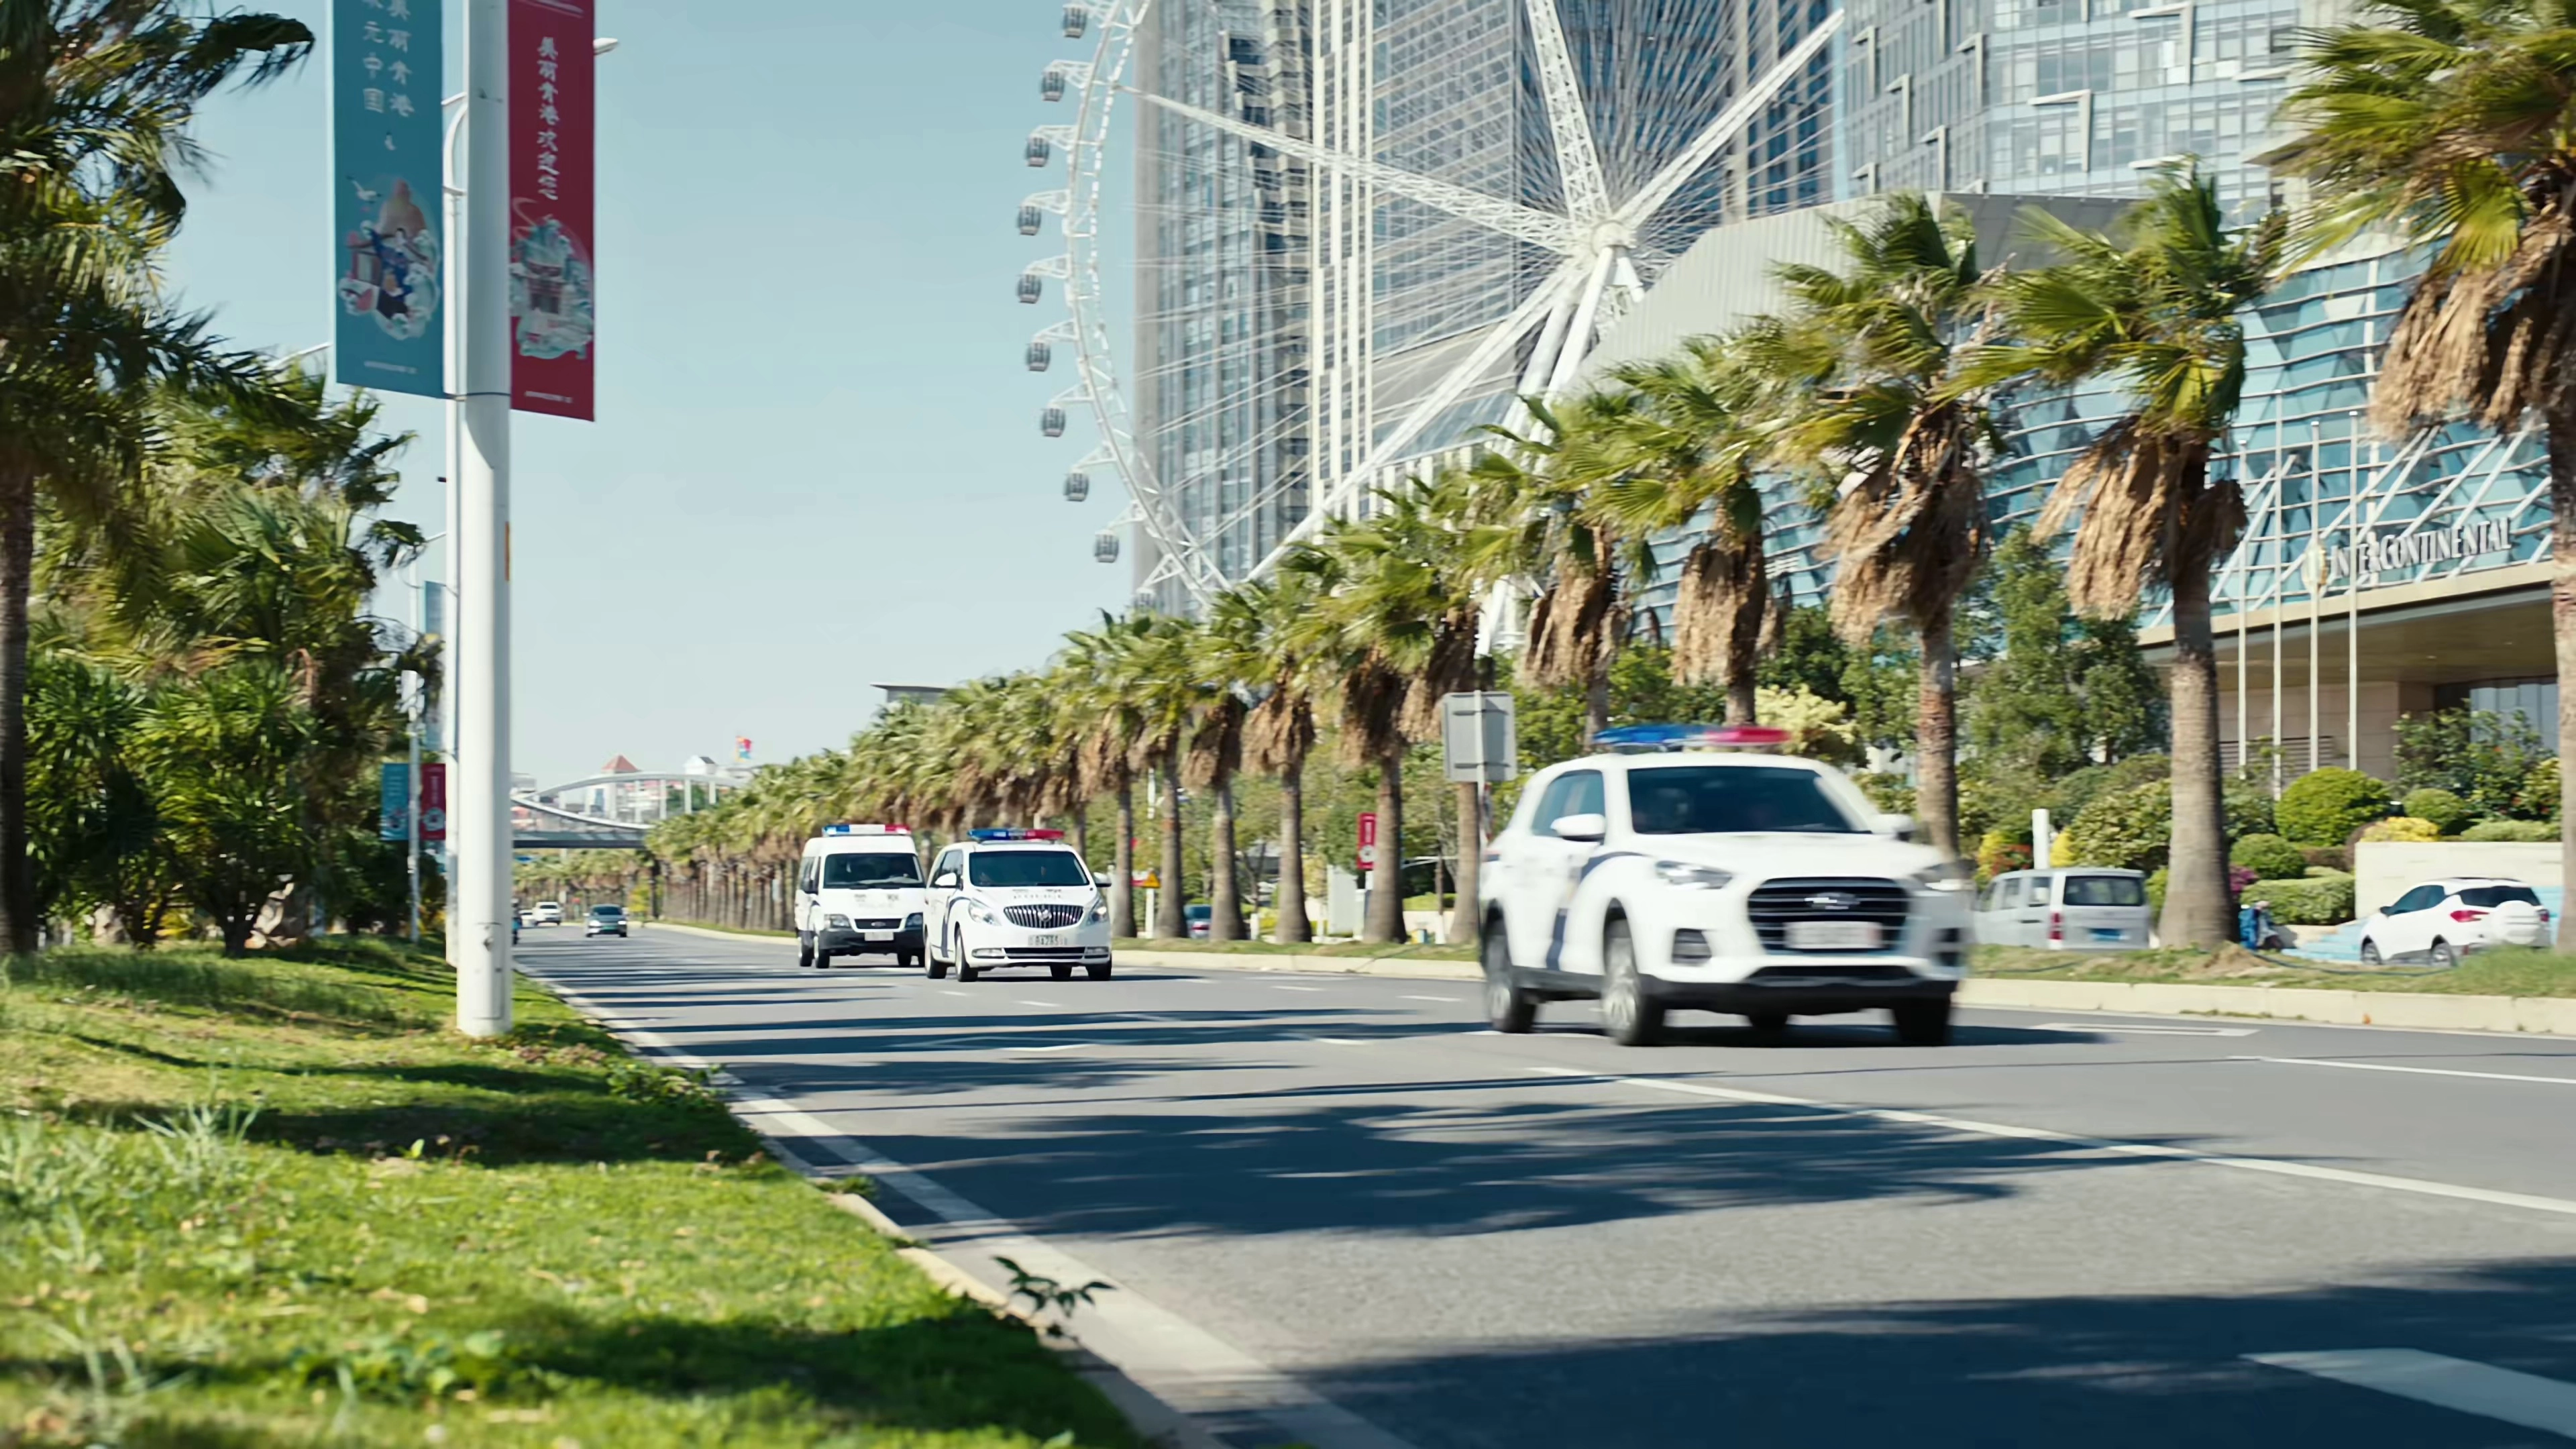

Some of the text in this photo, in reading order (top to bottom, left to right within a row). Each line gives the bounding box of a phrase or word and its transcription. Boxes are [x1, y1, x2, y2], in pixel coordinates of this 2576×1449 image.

[362, 0, 384, 113] 元中国
[2330, 517, 2512, 579] INERCONTINENTAL
